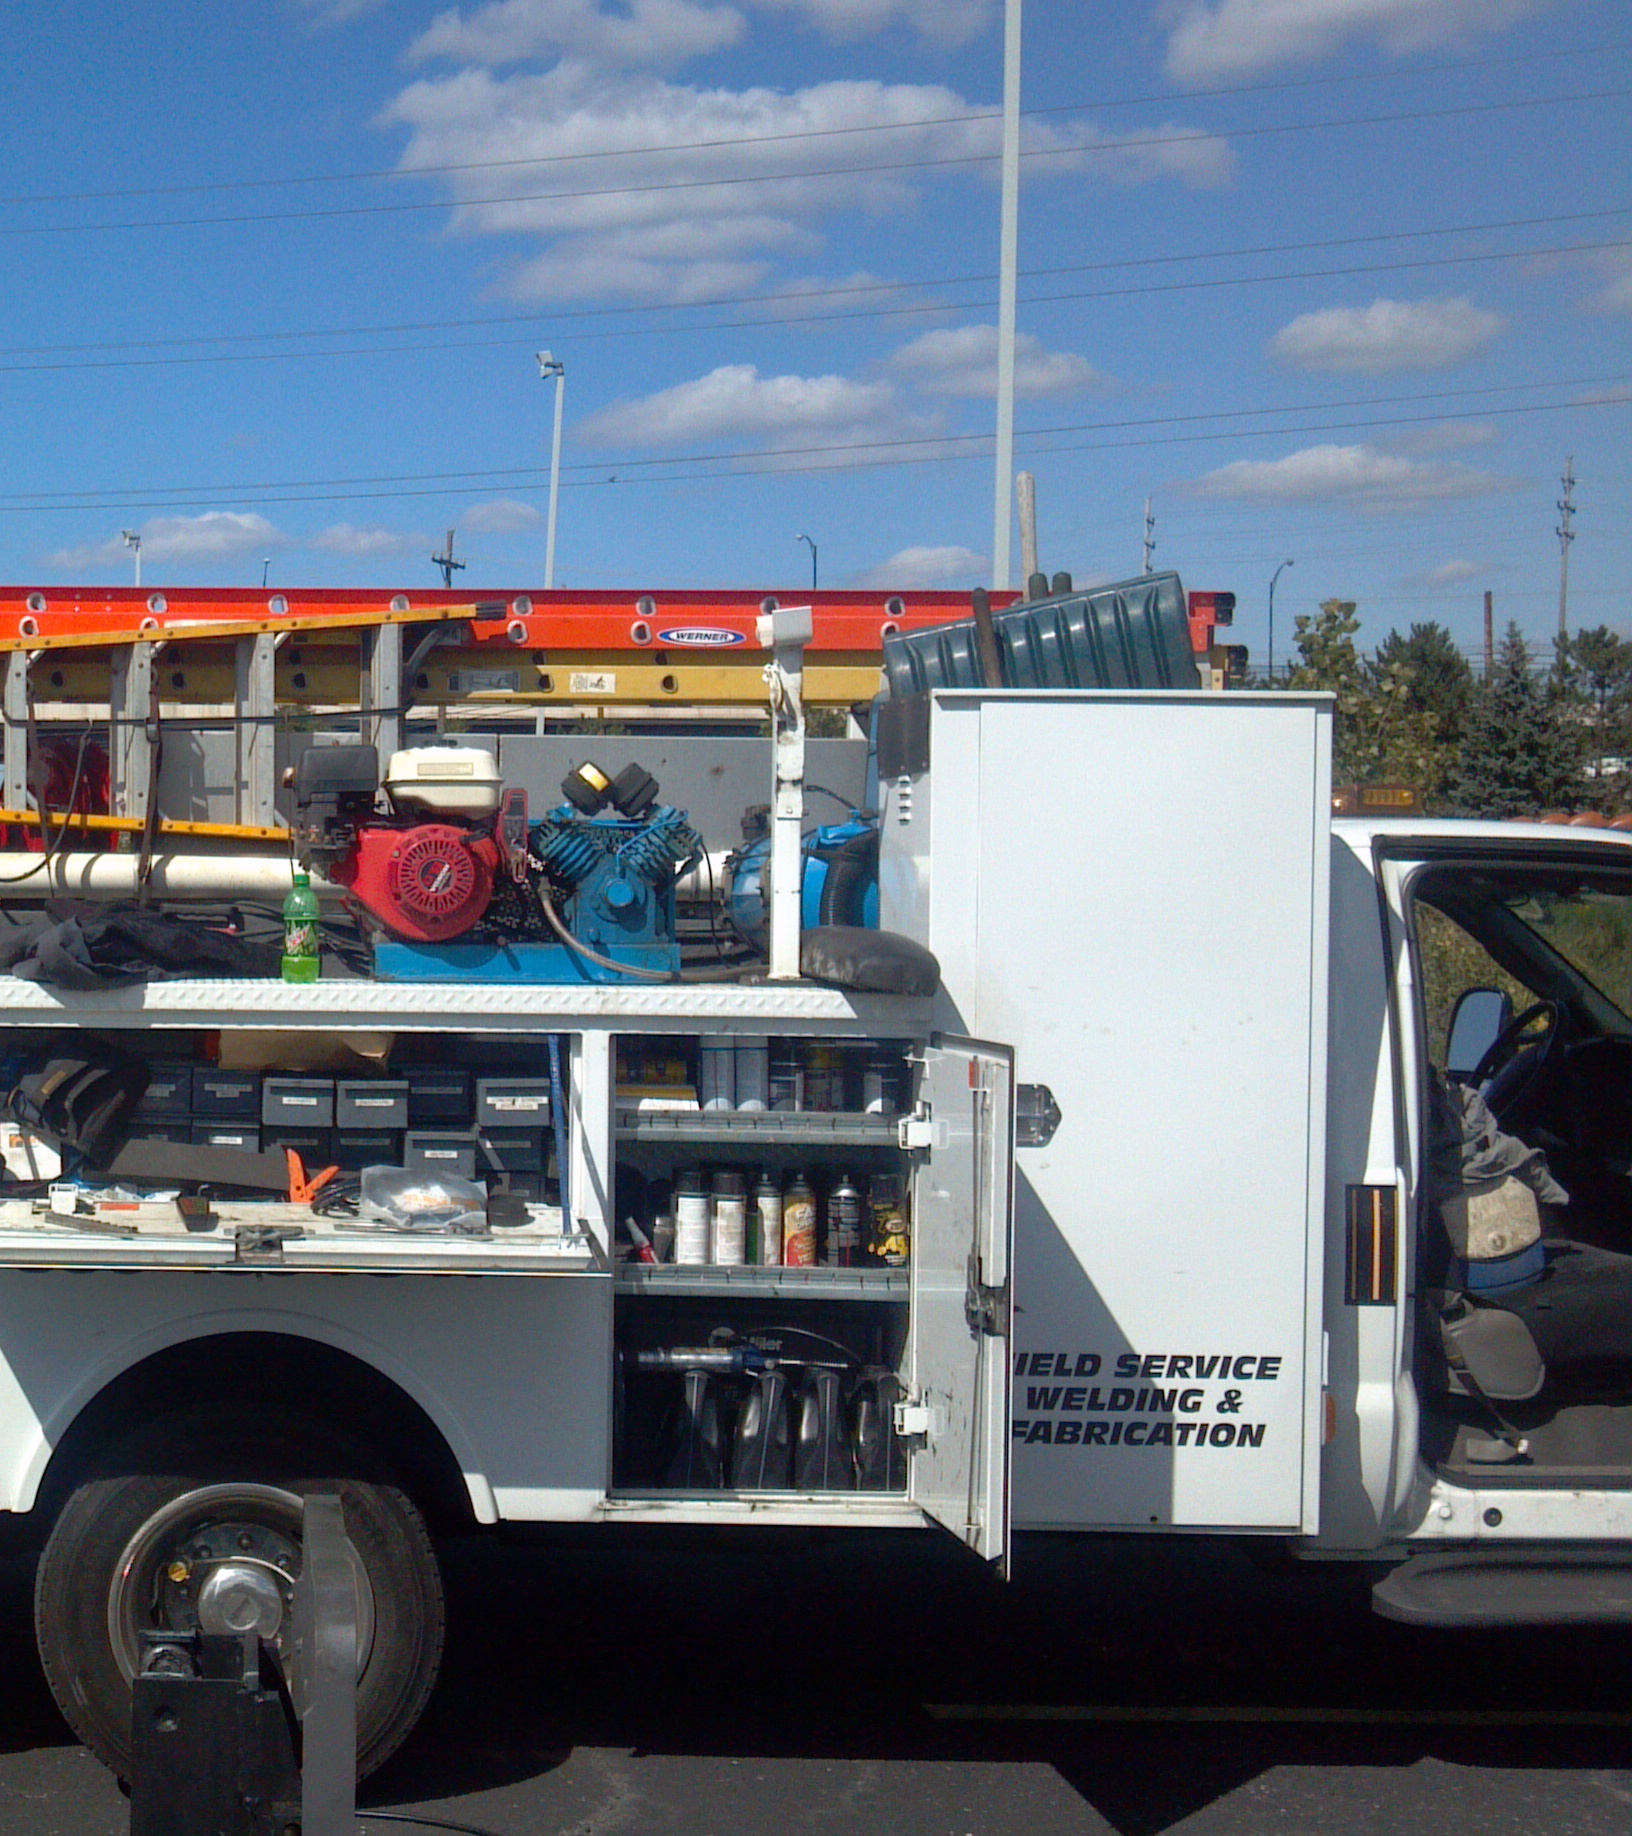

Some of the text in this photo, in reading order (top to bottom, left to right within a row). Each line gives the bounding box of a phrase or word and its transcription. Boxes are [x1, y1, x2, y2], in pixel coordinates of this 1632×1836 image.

[676, 632, 729, 641] WERNER
[1013, 1353, 1282, 1380] IELD SERVICE
[1026, 1386, 1244, 1413] WELDING &
